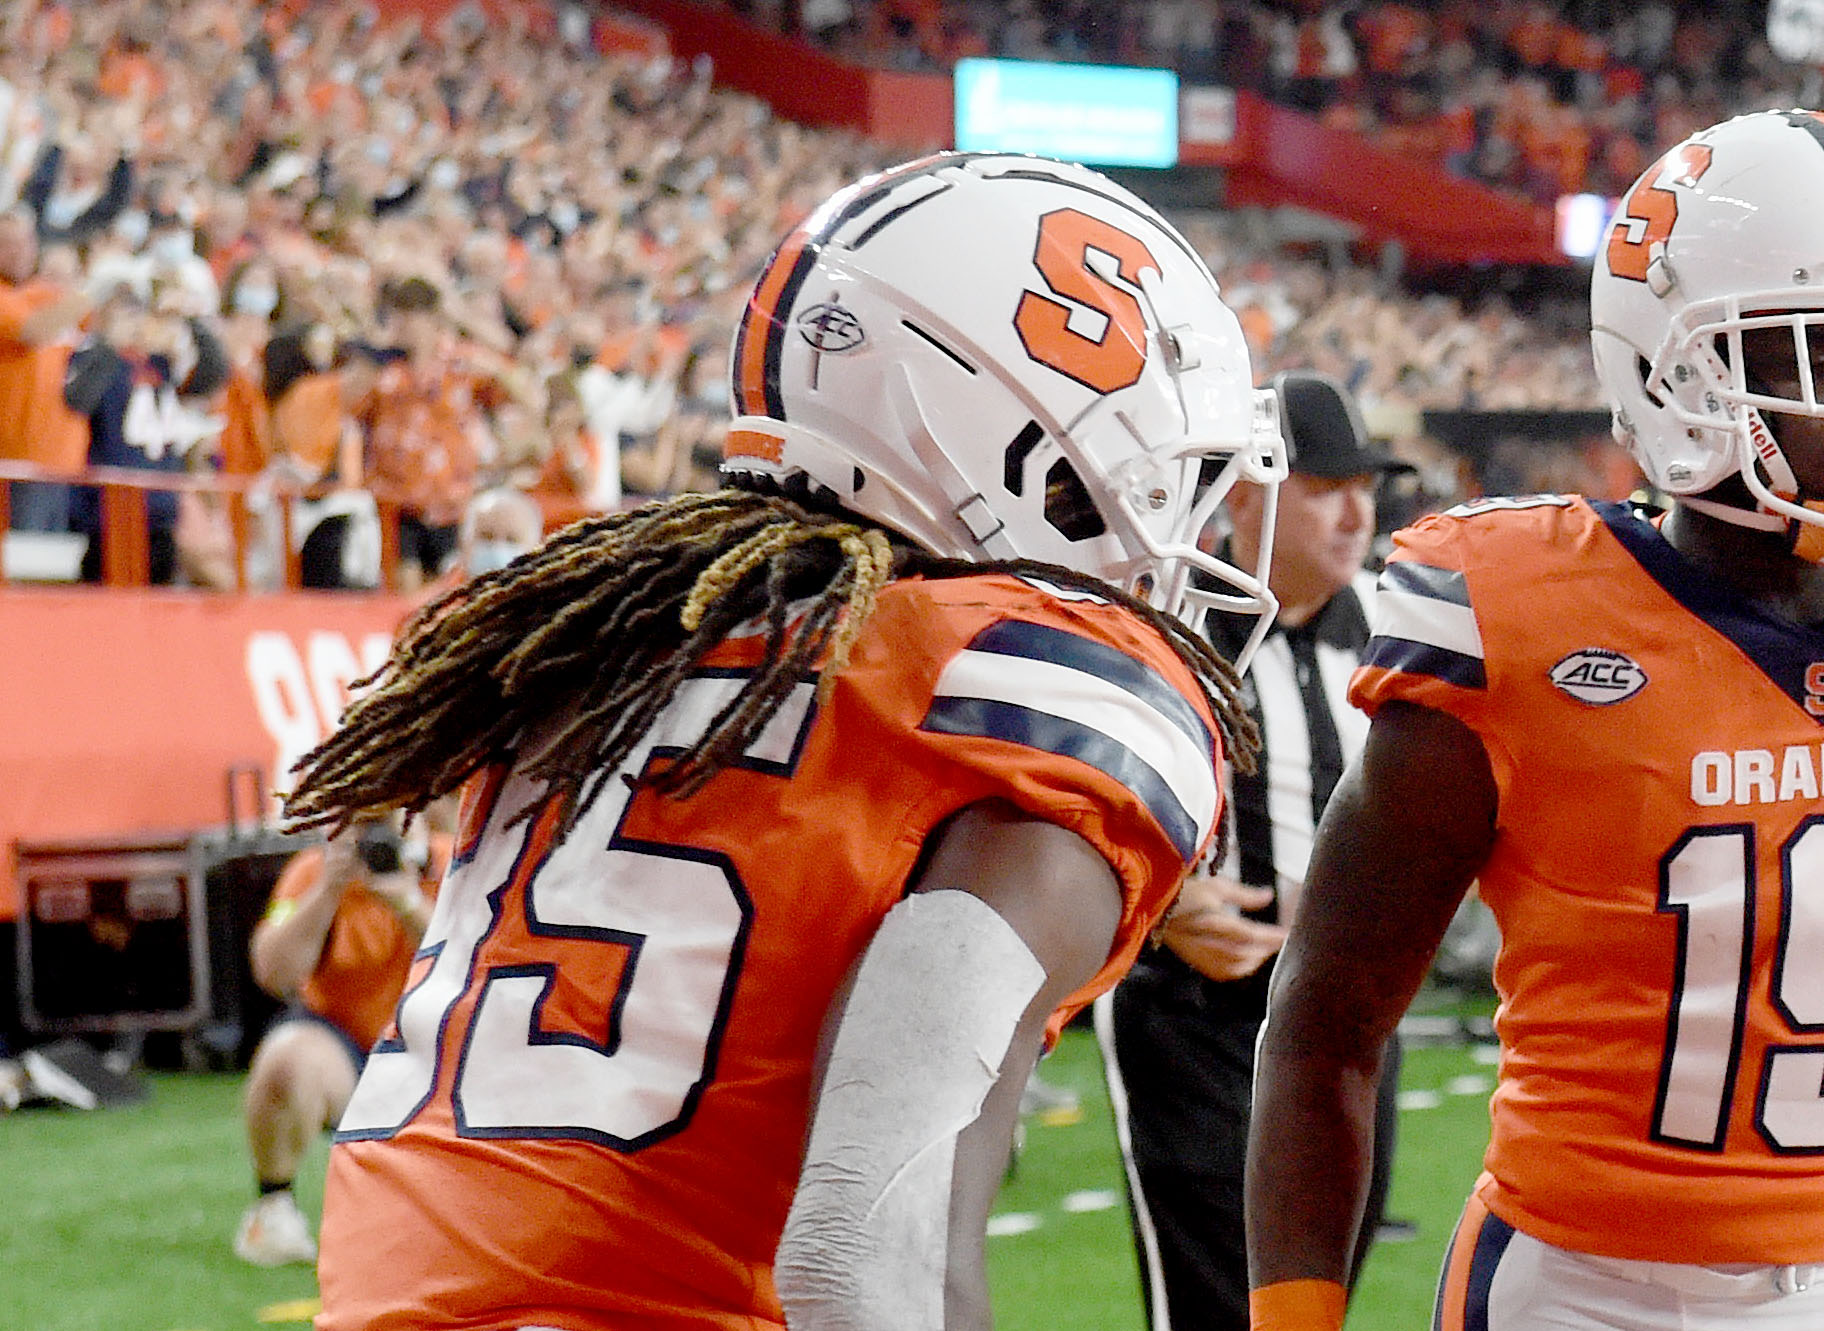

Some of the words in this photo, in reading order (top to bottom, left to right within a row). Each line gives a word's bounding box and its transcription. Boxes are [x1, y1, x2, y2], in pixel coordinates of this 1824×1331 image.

[1607, 143, 1714, 284] S
[1013, 207, 1163, 396] S
[1562, 662, 1634, 685] ACC
